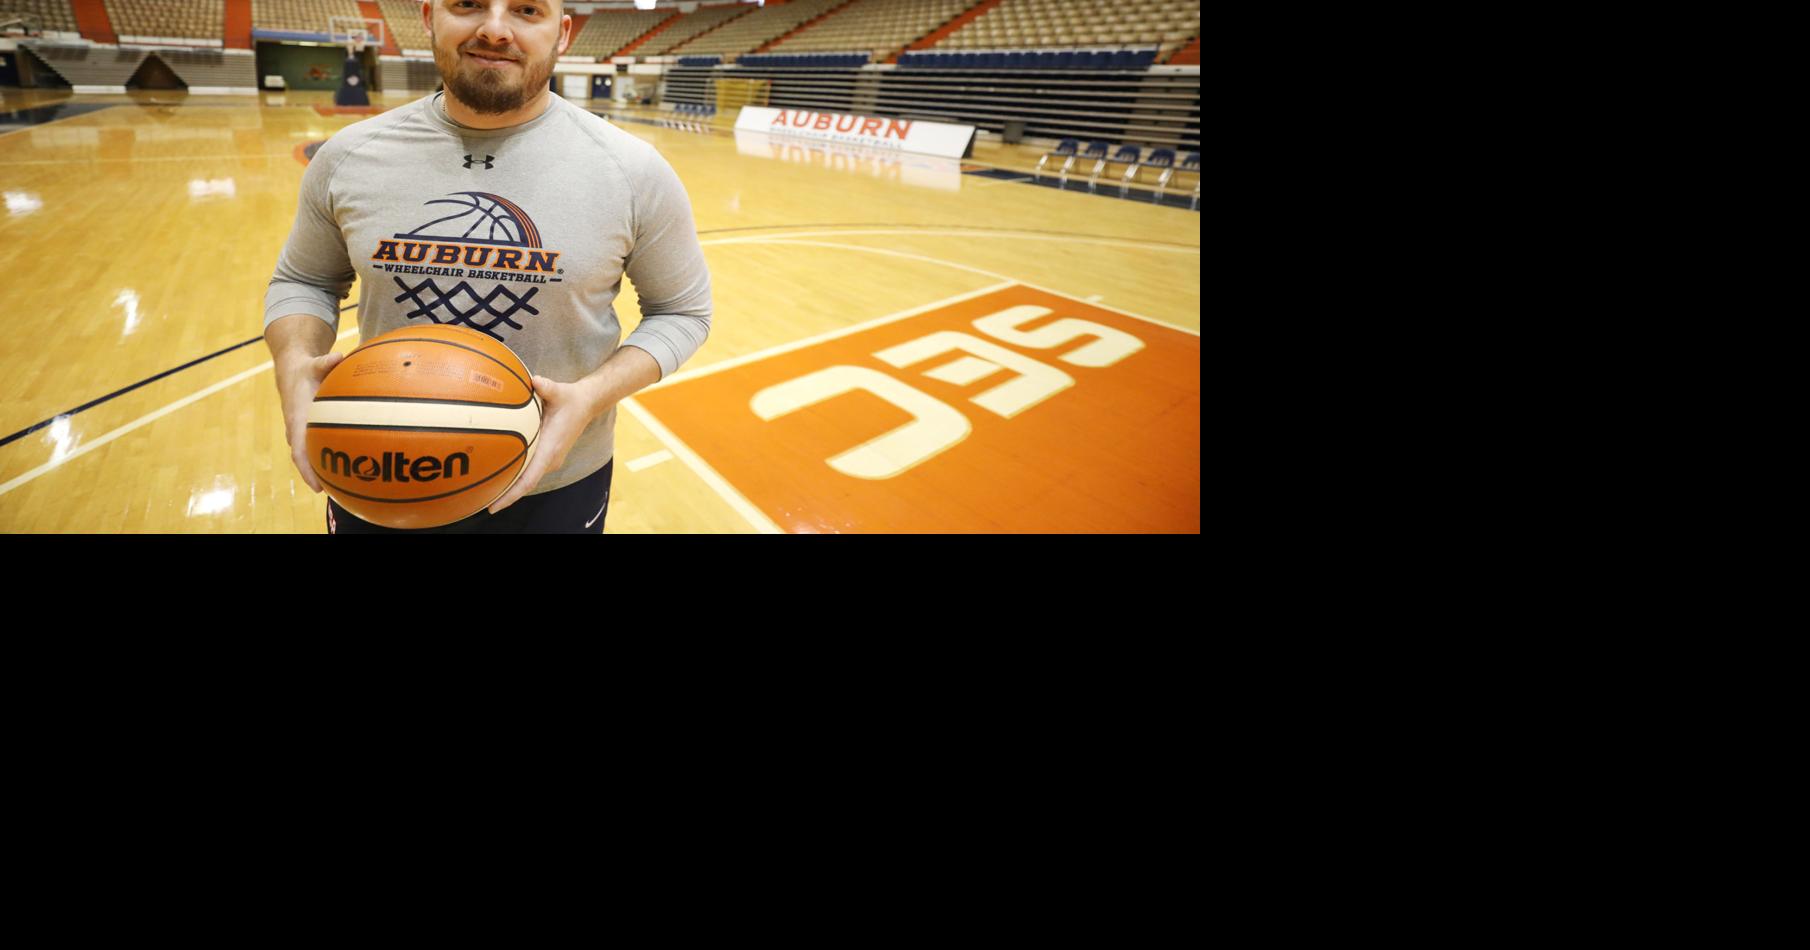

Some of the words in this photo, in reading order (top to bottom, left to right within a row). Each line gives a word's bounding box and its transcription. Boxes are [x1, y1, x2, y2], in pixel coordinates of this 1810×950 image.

[772, 110, 912, 140] AUBURN
[371, 240, 561, 274] AUBURN
[384, 263, 464, 277] WHEELCHAIR
[468, 269, 547, 284] BASKETBALL
[749, 305, 1146, 480] SEC
[320, 447, 470, 482] molten
